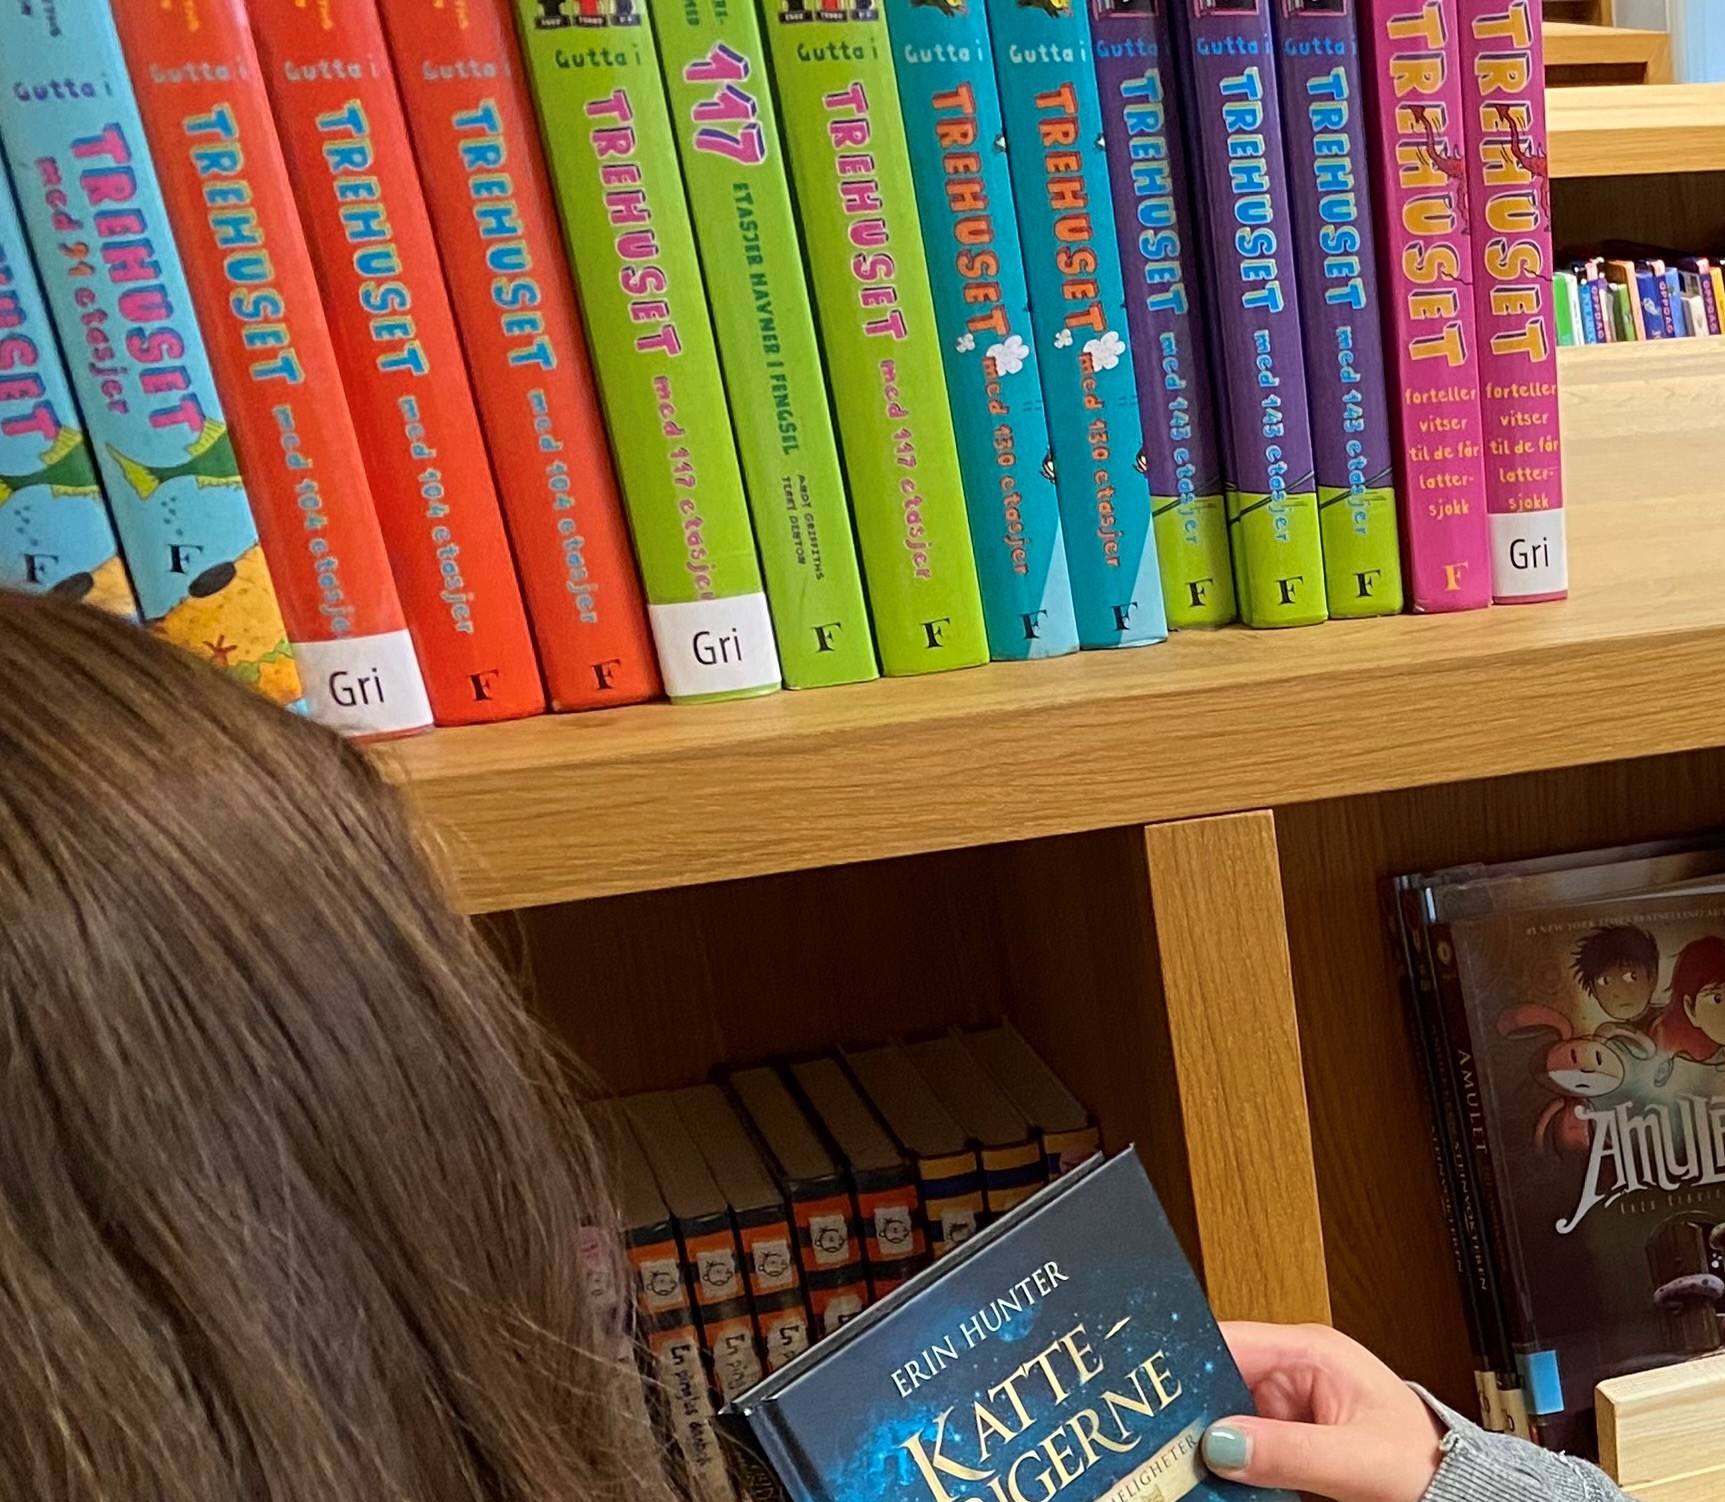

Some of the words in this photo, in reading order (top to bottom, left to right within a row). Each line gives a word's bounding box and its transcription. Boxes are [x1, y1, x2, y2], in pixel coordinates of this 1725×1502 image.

[683, 41, 767, 165] 117
[34, 156, 84, 232] med
[1034, 81, 1108, 333] TREHUSET
[1306, 66, 1367, 310] TREHUSET
[1387, 0, 1468, 367] TREHUSET
[1471, 0, 1549, 363] TREHUSET
[584, 88, 682, 357] TREHUSET
[822, 81, 907, 340] TREHUSET
[58, 241, 96, 278] 91
[183, 101, 305, 385] TREHUSET
[315, 98, 430, 377] TREHUSET
[70, 121, 206, 433] TREHUSET
[733, 182, 764, 266] ETASJER
[750, 272, 781, 358] HAVNER
[769, 373, 800, 455] FENGSEL
[653, 375, 685, 439] med
[880, 359, 909, 420] med
[982, 356, 1009, 416] med
[1342, 389, 1365, 433] 143
[1405, 386, 1477, 405] forteller
[1486, 382, 1557, 400] forteller
[397, 395, 438, 460] med
[527, 388, 564, 453] med
[1087, 419, 1111, 461] 130
[1170, 396, 1193, 441] 143
[1261, 394, 1285, 438] 143
[1419, 418, 1468, 433] vitser
[1499, 412, 1548, 427] vitser
[271, 404, 313, 470] med
[295, 478, 329, 530] 104
[668, 446, 697, 488] 117
[893, 427, 917, 469] 117
[993, 423, 1015, 467] 130
[1408, 446, 1432, 462] til
[1434, 446, 1454, 461] de
[1489, 438, 1510, 455] til
[1513, 439, 1533, 454] de
[417, 467, 451, 519] 104
[545, 460, 576, 511] 104
[1419, 472, 1474, 490] latter-
[1499, 467, 1554, 484] latter-
[1509, 536, 1549, 571] Gri
[692, 627, 743, 667] Gri
[328, 666, 385, 708] Gri
[1457, 1049, 1488, 1156] AMULET
[891, 1335, 959, 1398] ERIN
[960, 1260, 1070, 1349] HUNTER
